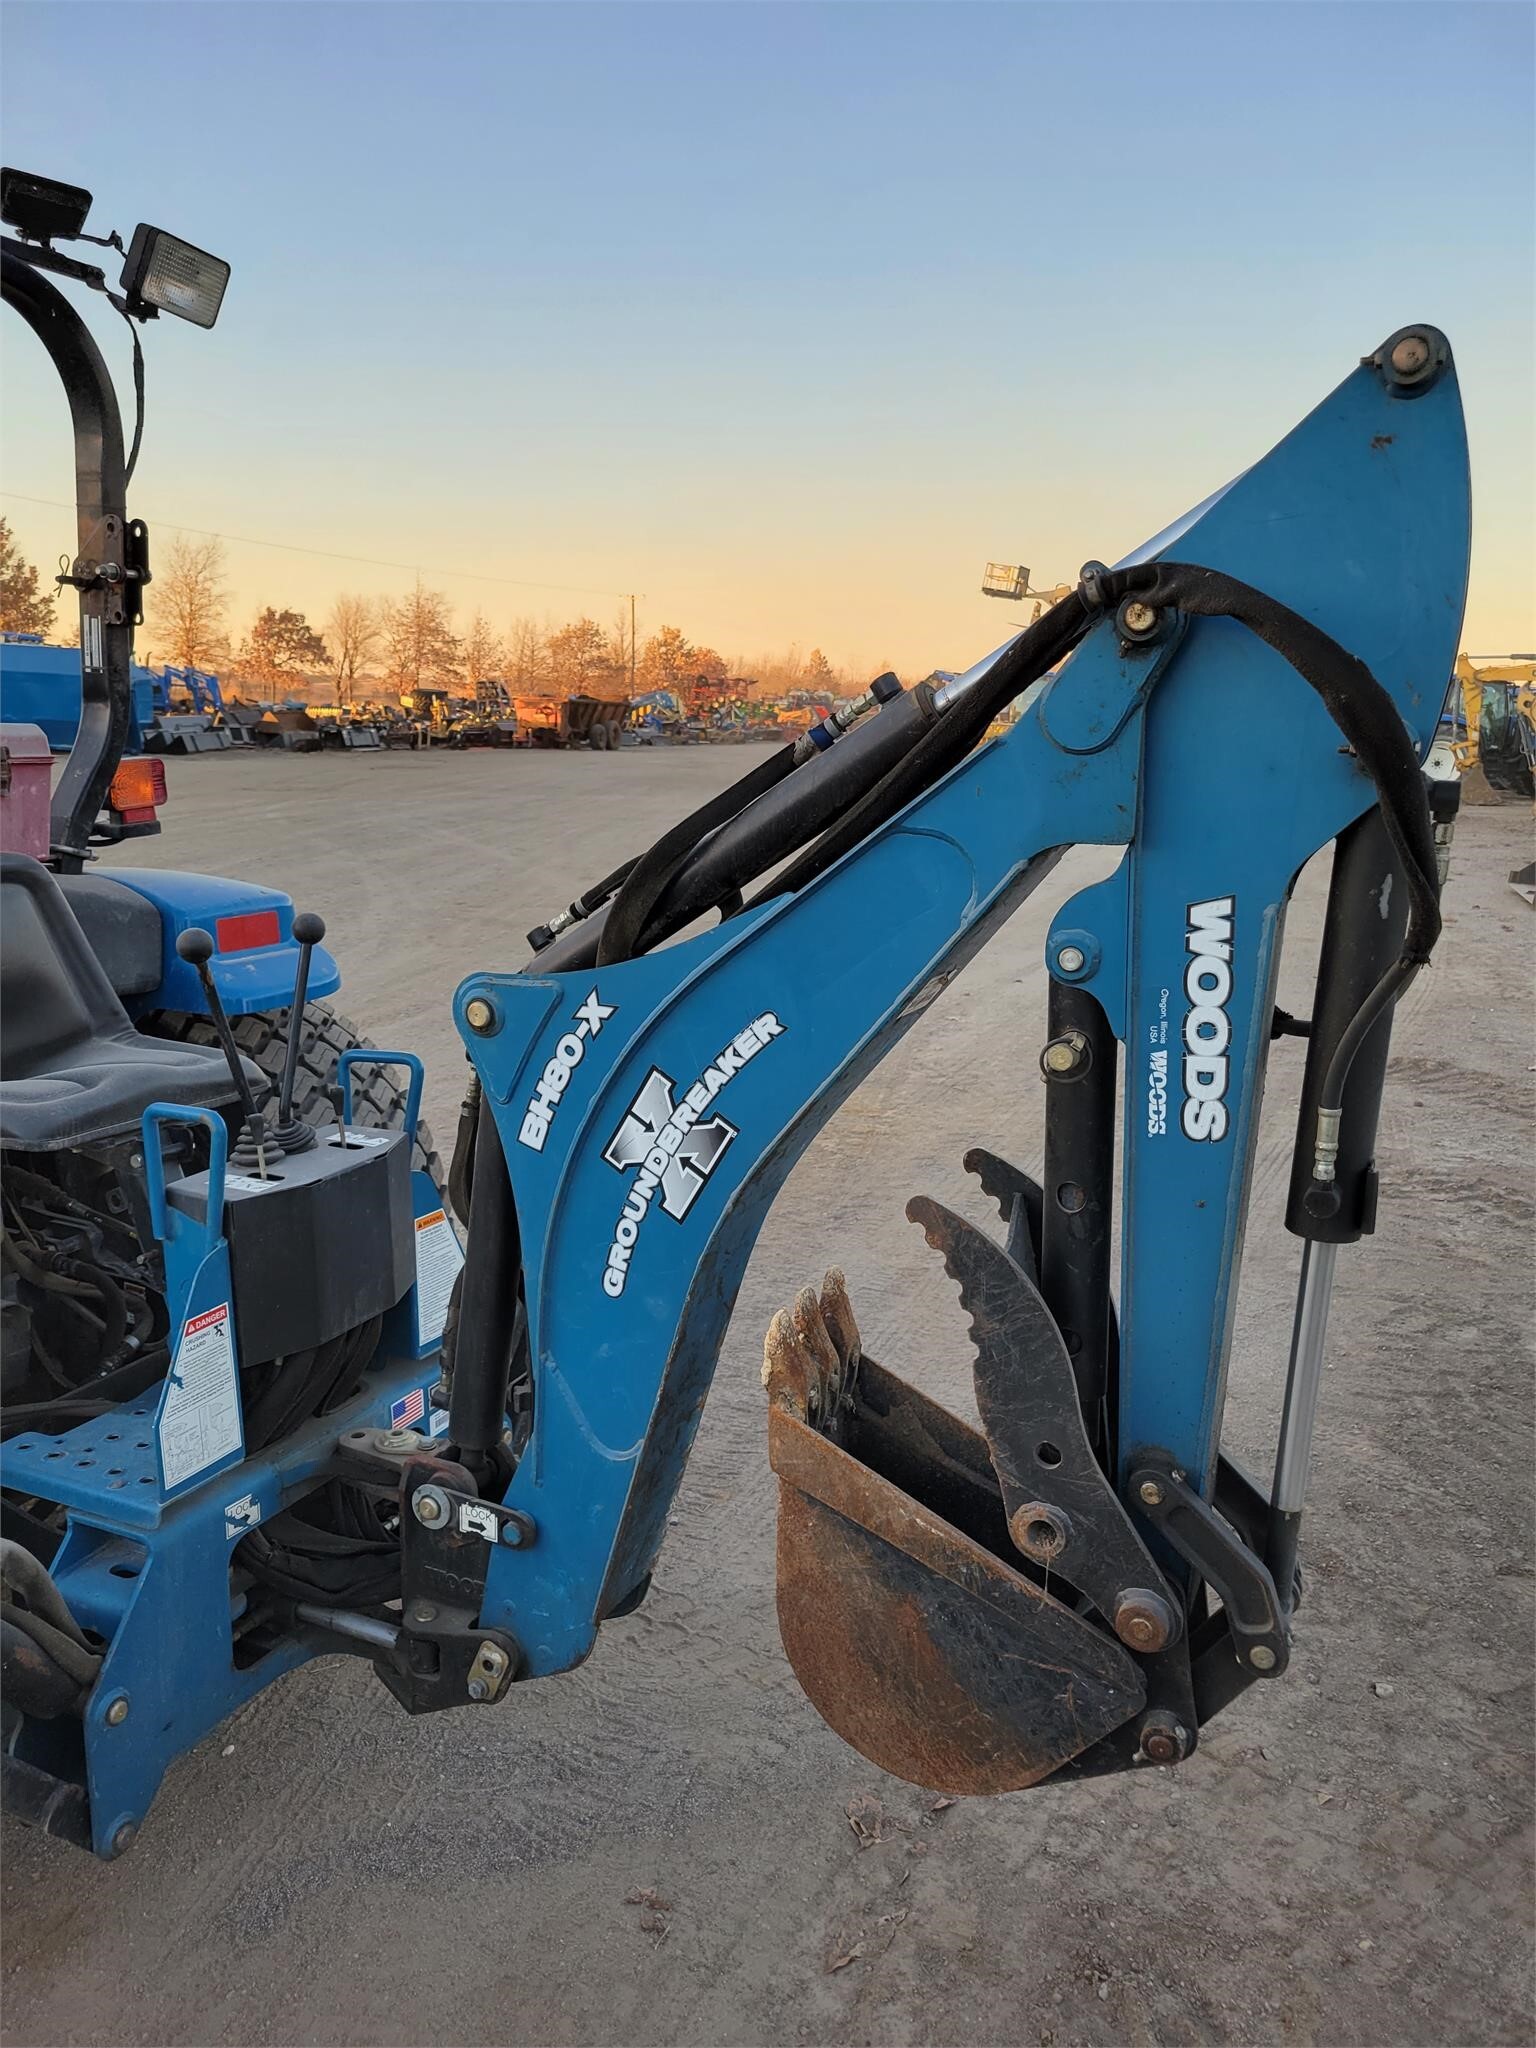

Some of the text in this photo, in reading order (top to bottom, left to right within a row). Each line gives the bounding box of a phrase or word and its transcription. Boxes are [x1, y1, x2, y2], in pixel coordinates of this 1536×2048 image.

[1150, 1025, 1158, 1044] USA
[1159, 988, 1169, 1044] Oregon, Illinois
[1180, 894, 1236, 1143] WOODS
[517, 986, 619, 1152] BH80-X
[1148, 1050, 1168, 1136] WOODS
[603, 1011, 787, 1298] GROUNDBREAKER
[195, 1309, 226, 1327] DANGER
[185, 1331, 210, 1346] CRUSHING
[186, 1340, 206, 1352] HAZARD
[465, 1507, 492, 1521] LOCK
